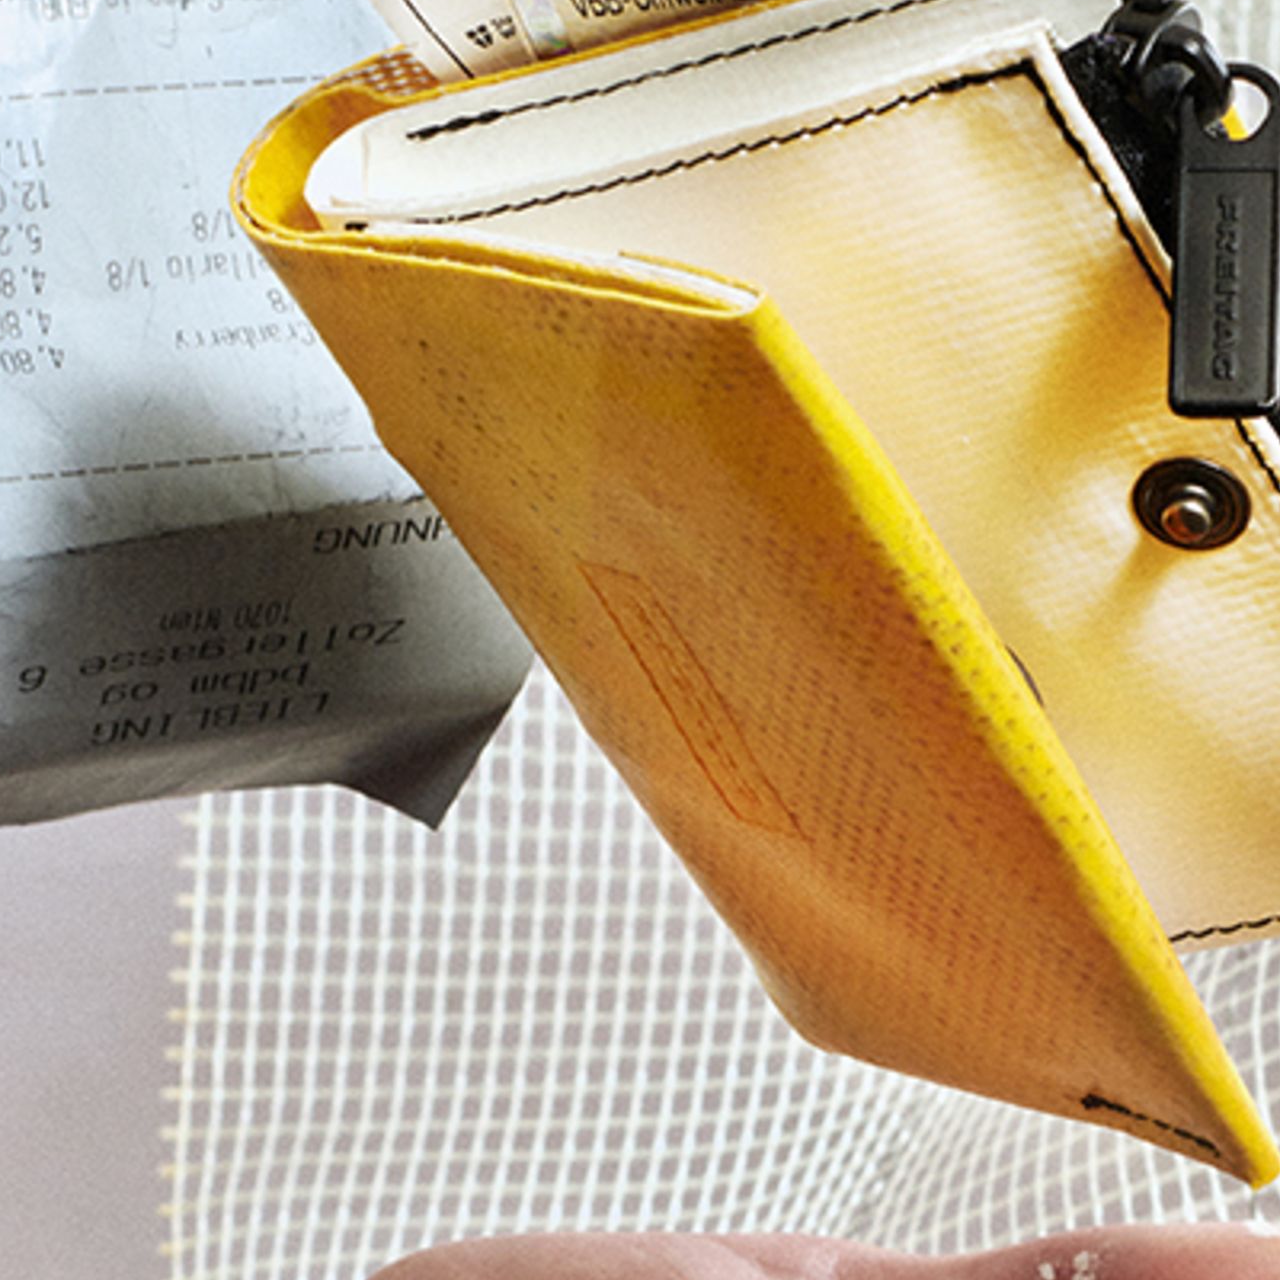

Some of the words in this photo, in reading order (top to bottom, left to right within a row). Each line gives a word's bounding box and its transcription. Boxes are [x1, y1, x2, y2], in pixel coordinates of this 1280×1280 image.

[105, 258, 150, 292] 1/8
[1211, 193, 1241, 382] FREITAG
[79, 619, 404, 678] Zollergasse
[19, 665, 47, 692] 6
[100, 680, 159, 705] og
[189, 662, 309, 695] bdbm
[91, 689, 330, 744] LIEBLING
